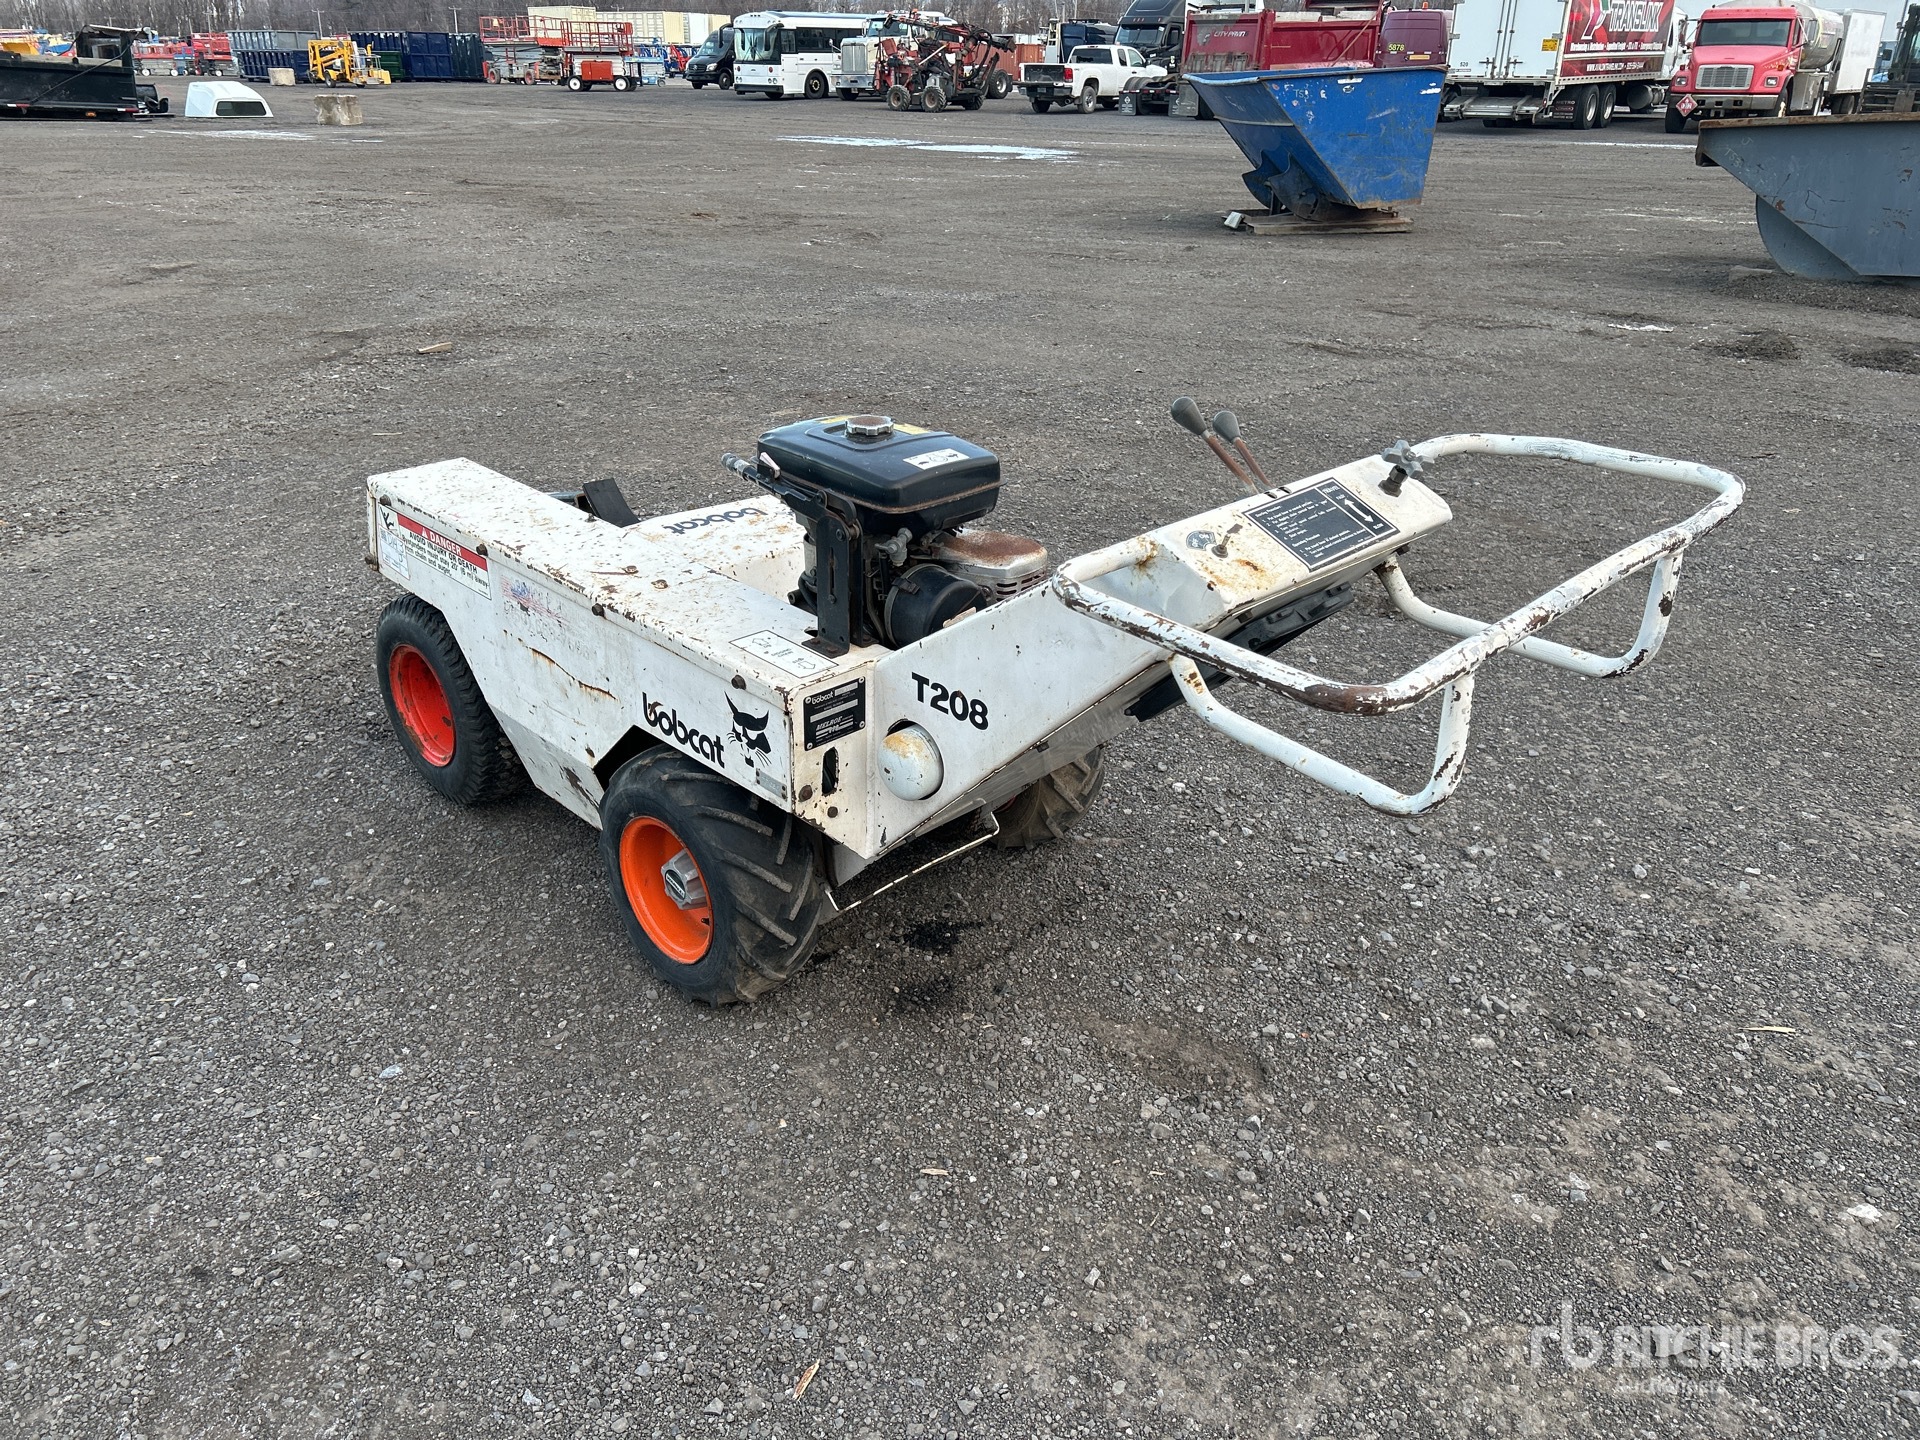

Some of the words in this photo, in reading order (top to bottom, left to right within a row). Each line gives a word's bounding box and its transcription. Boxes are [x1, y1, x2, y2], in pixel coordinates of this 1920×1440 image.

[1609, 1, 1664, 32] TRANSLINK
[1388, 43, 1405, 51] 5878
[663, 507, 769, 535] bobcat
[409, 531, 426, 546] AVOID
[426, 541, 447, 557] INJURY
[448, 552, 457, 563] OR
[457, 557, 478, 574] DEATH
[429, 532, 462, 556] DANGER
[812, 690, 834, 705] bobcat
[911, 671, 989, 731] T208
[642, 691, 725, 769] bobcat
